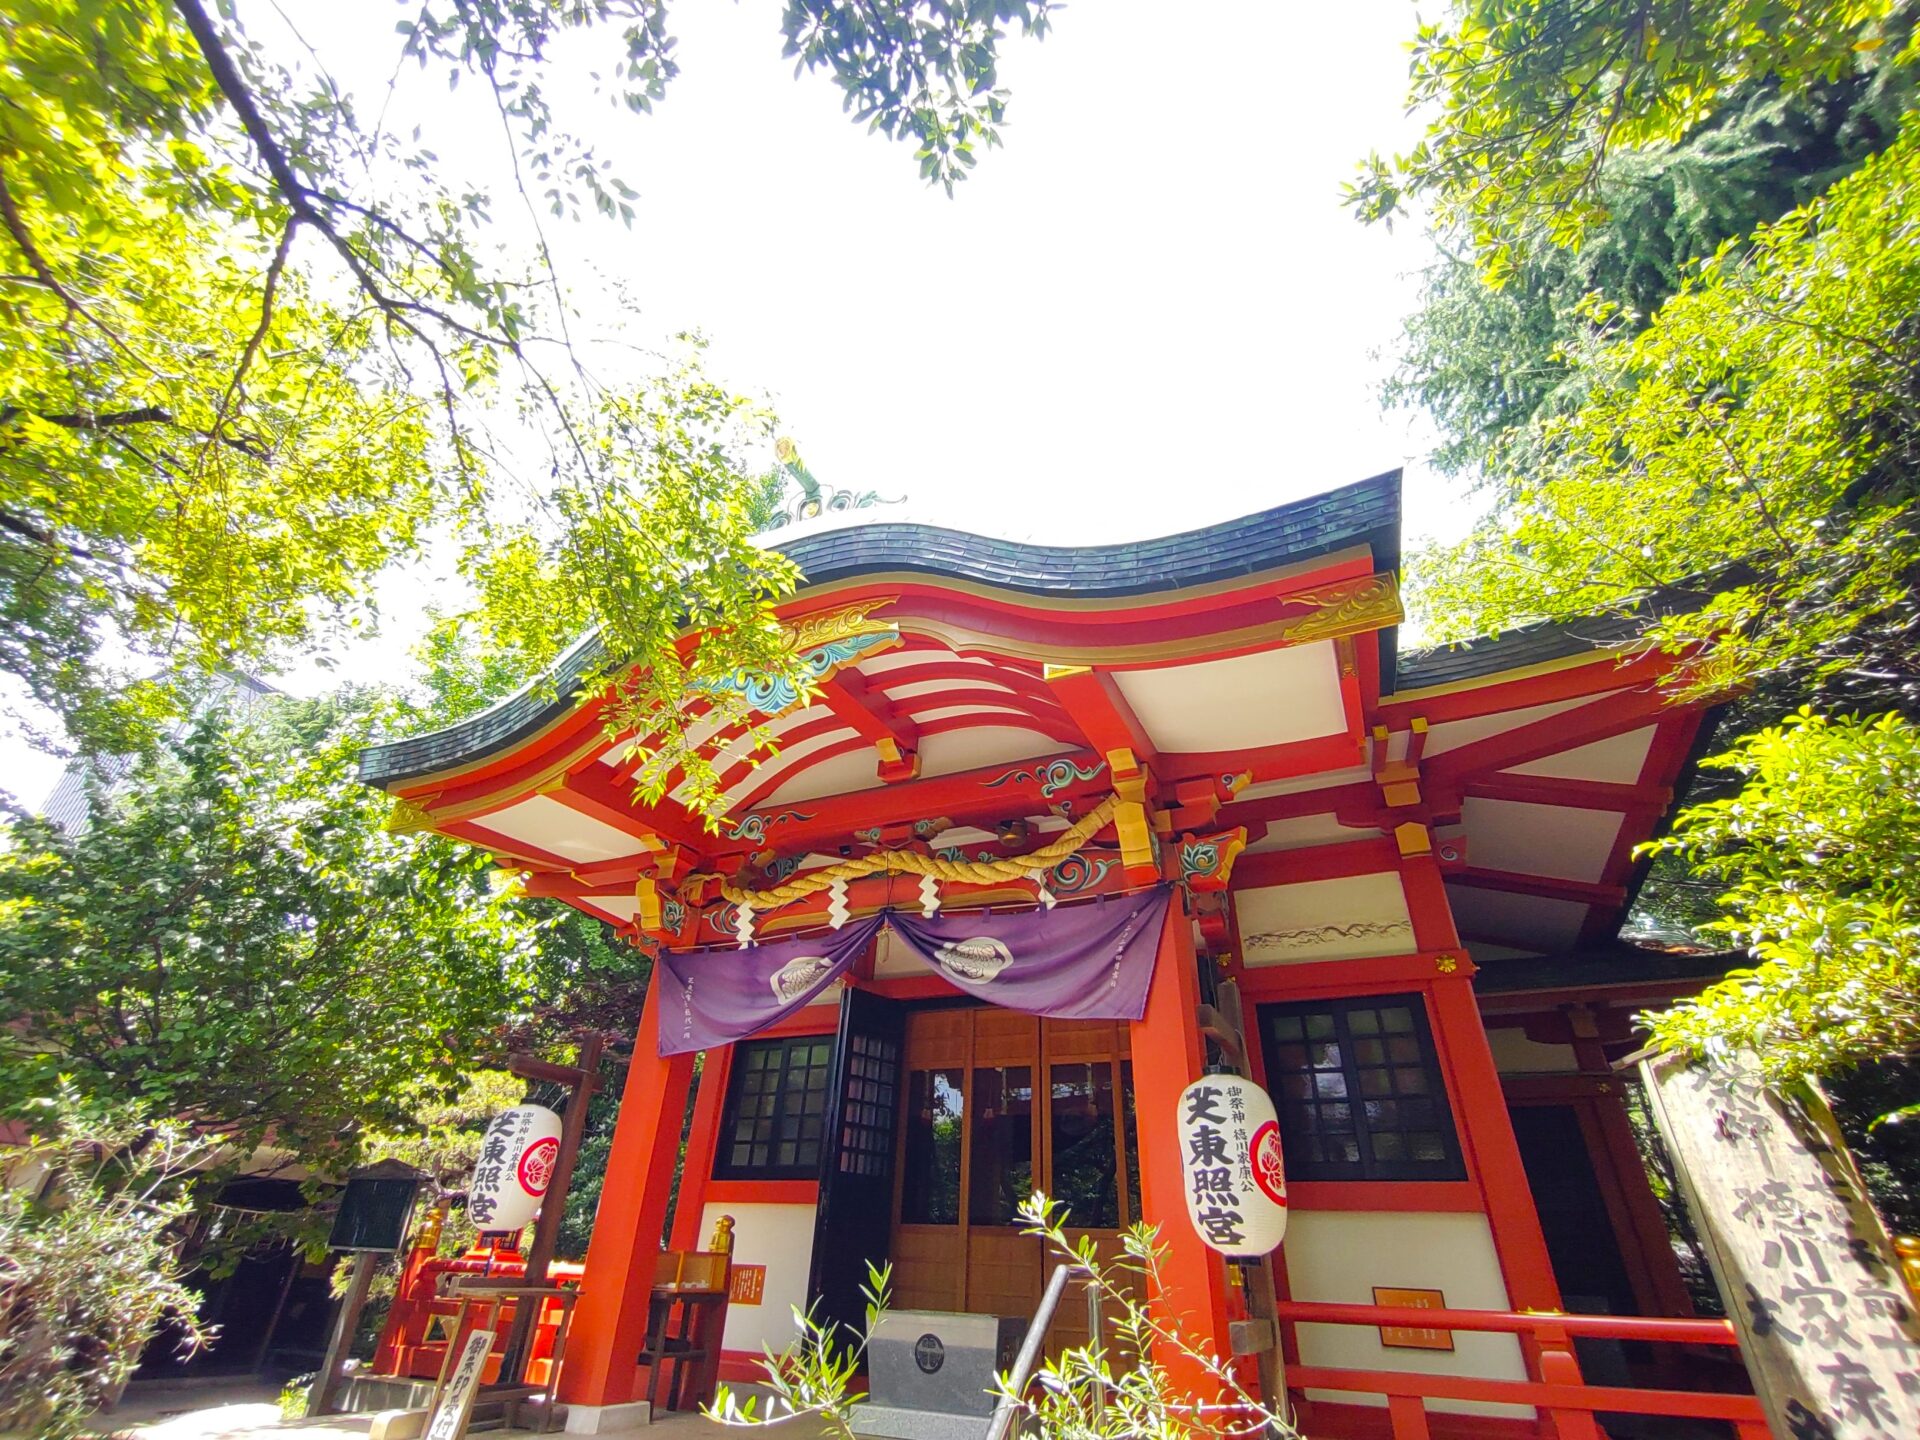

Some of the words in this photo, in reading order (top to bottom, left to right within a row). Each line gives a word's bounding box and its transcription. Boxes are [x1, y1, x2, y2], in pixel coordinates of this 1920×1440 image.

[469, 1111, 520, 1225] 芝東照宮
[1186, 1086, 1246, 1246] 芝東照宮
[430, 1335, 488, 1440] 御朱印受付
